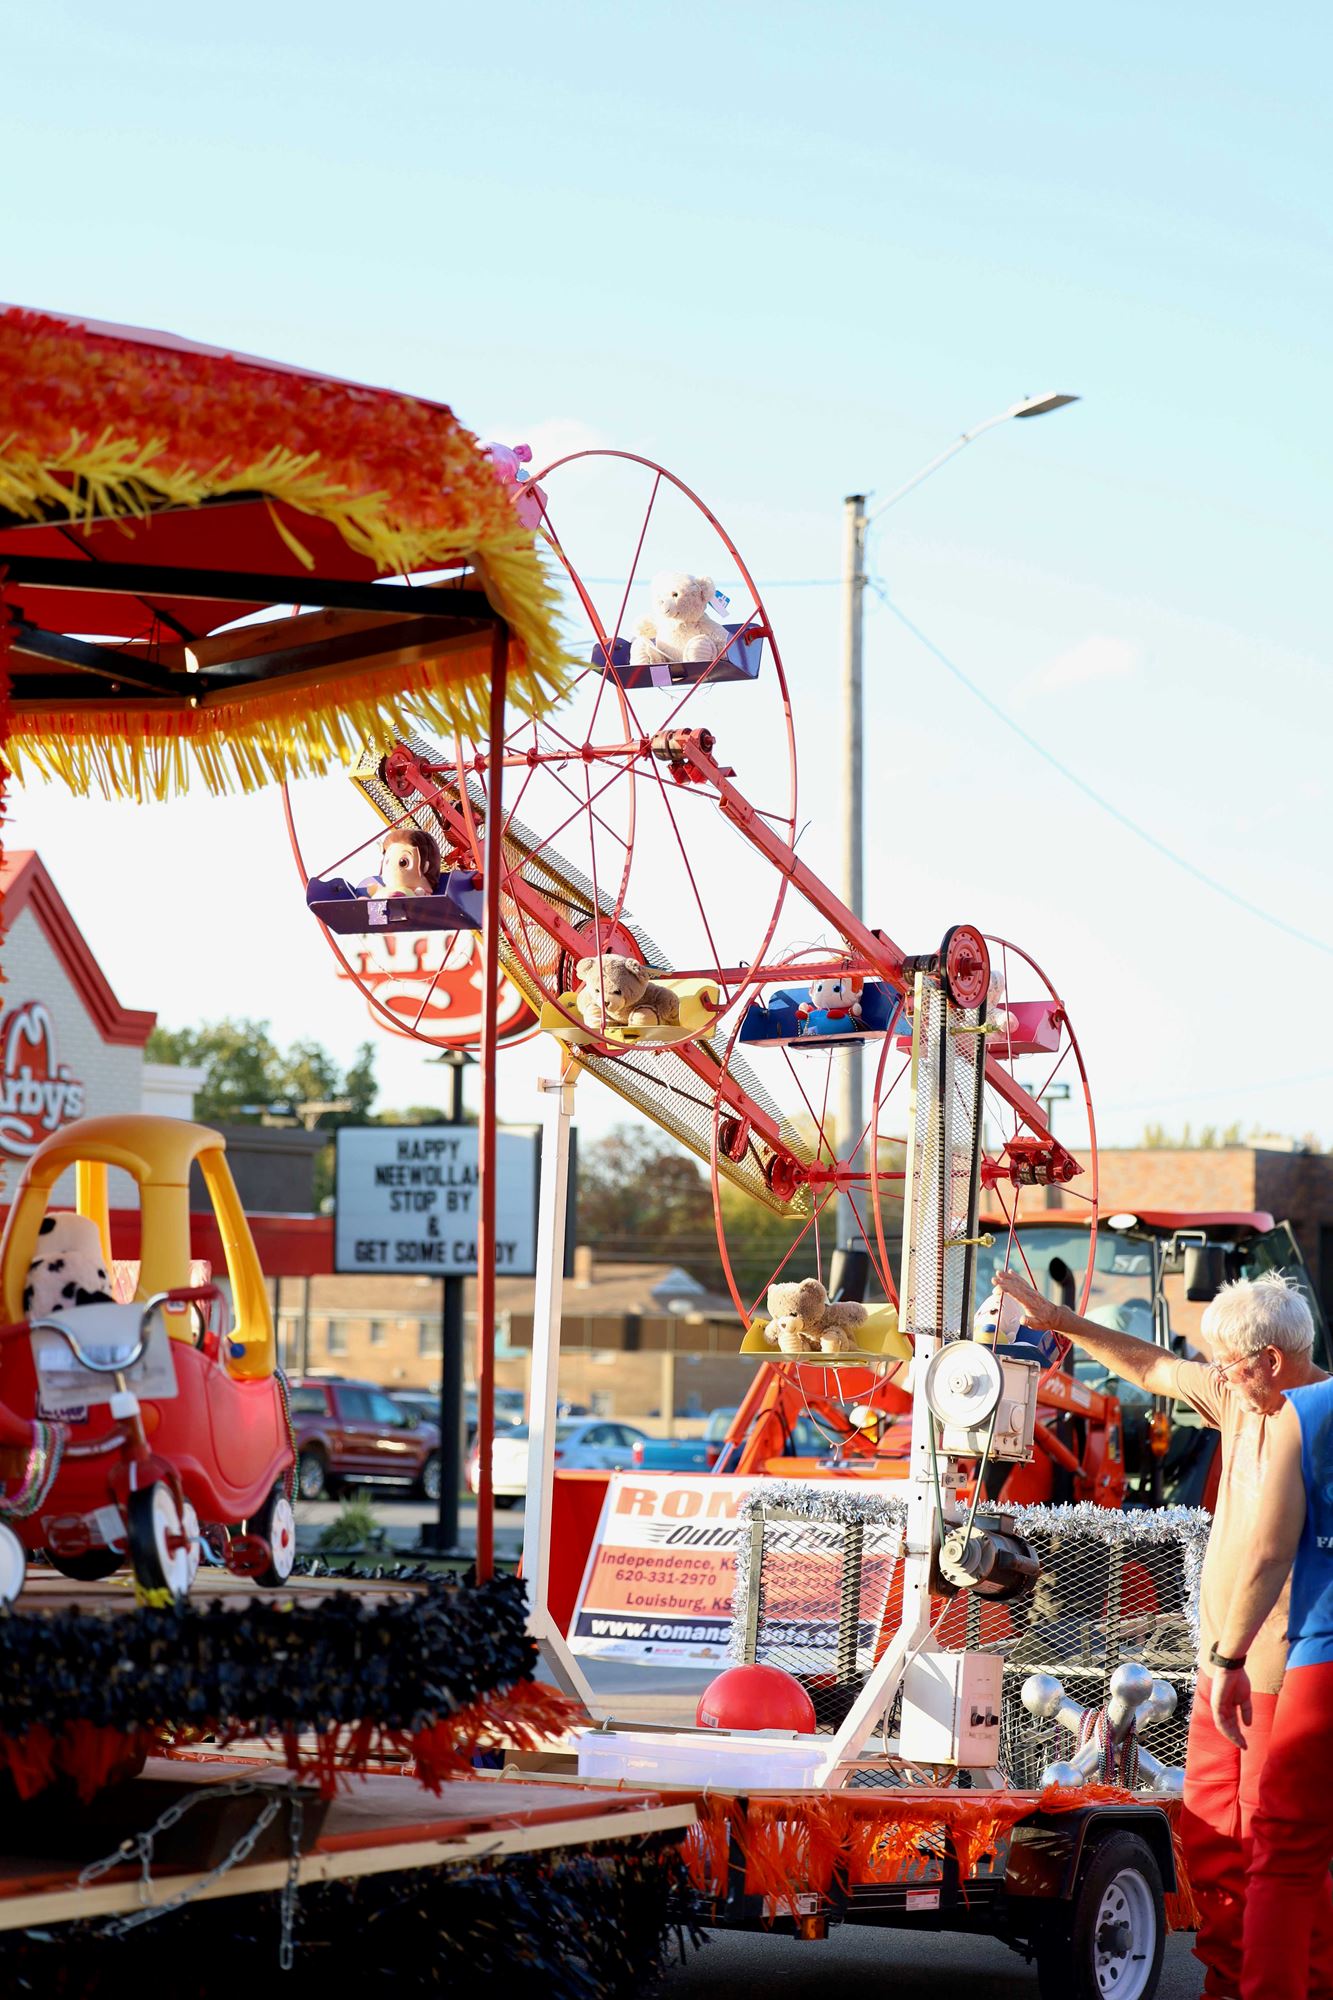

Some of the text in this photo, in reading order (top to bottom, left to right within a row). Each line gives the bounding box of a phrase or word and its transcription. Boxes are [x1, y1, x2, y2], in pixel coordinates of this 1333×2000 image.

[0, 1065, 84, 1131] rby's
[397, 1139, 460, 1161] HAPPY
[389, 1190, 473, 1213] STOP BY
[426, 1216, 439, 1238] &
[354, 1240, 518, 1265] GET SOME CADY
[601, 1551, 739, 1572] Independence, KS
[615, 1569, 717, 1586] 620-331-2970
[626, 1592, 733, 1612] Louisburg, KS
